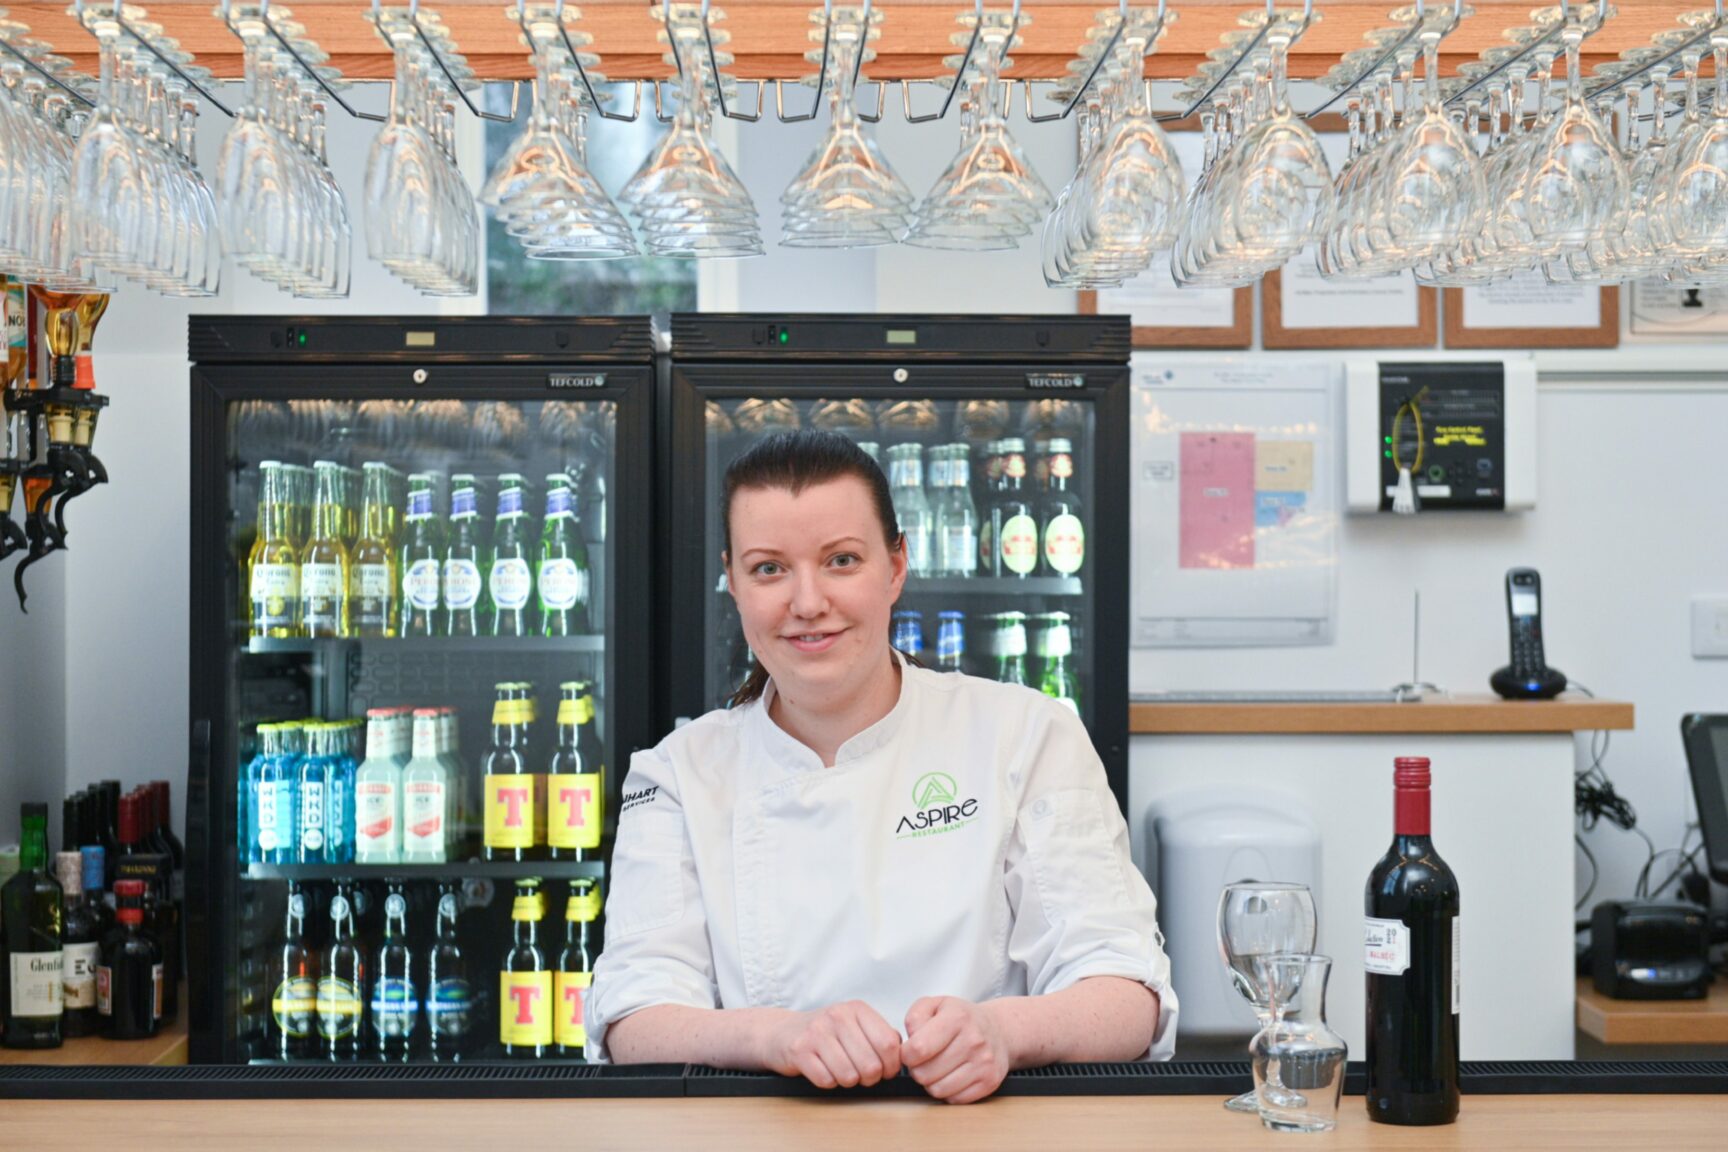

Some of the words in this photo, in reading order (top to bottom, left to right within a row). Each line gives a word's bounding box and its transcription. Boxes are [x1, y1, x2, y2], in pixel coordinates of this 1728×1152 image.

[550, 377, 594, 387] TEFCOLD
[1028, 377, 1073, 387] TEFCOLD
[498, 789, 528, 826] T
[560, 789, 590, 826] T
[911, 821, 965, 838] RESTAURANT
[510, 986, 540, 1024] T
